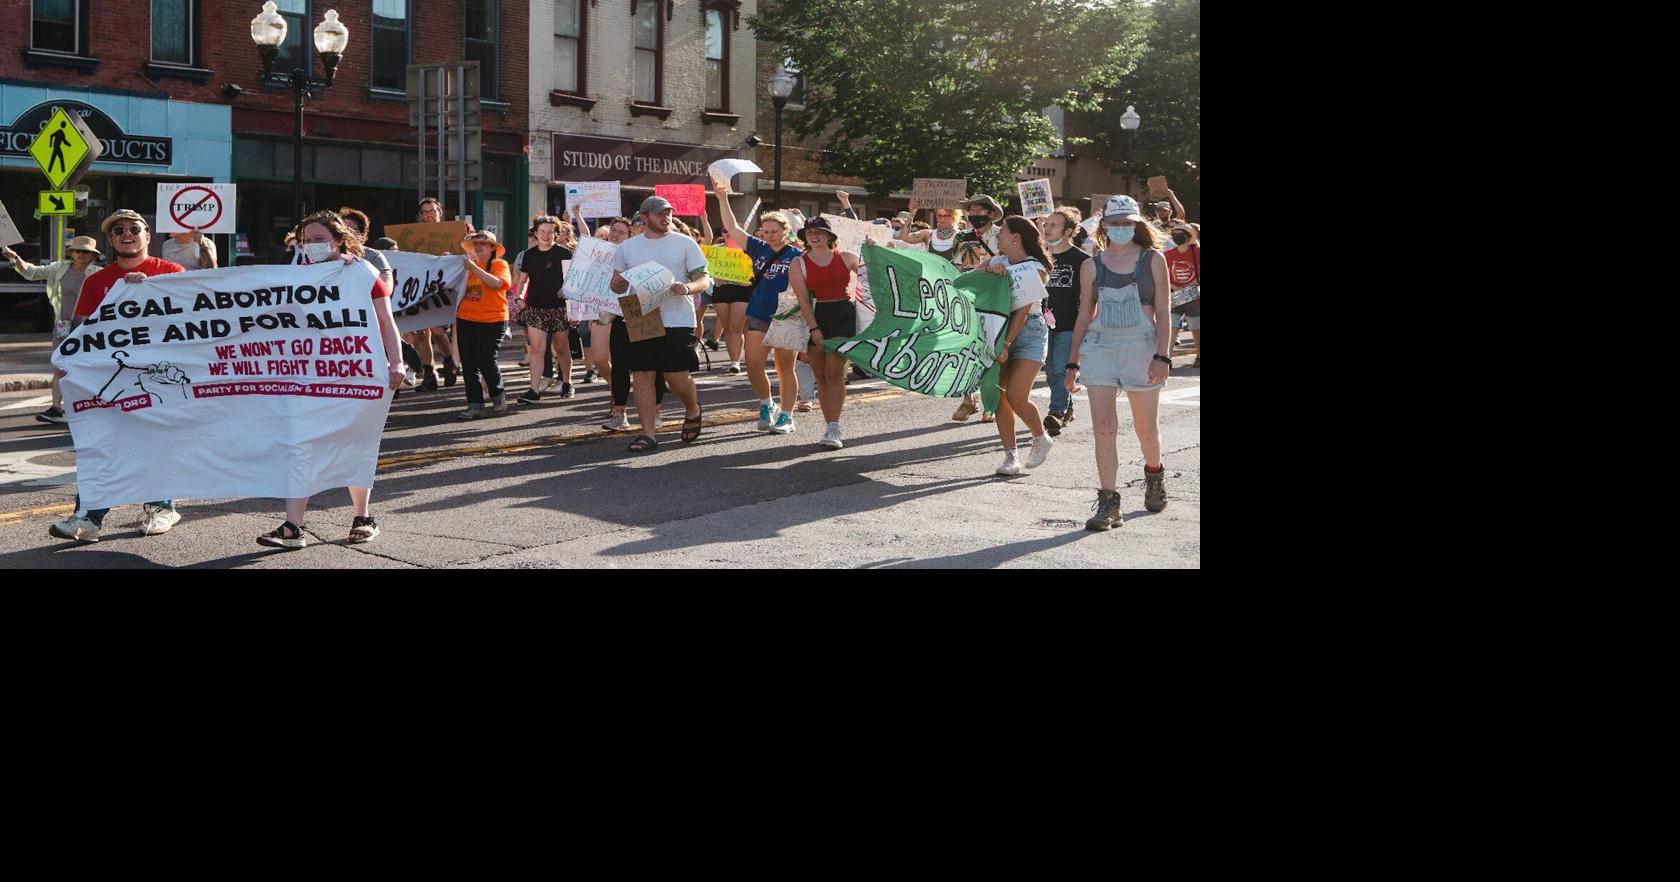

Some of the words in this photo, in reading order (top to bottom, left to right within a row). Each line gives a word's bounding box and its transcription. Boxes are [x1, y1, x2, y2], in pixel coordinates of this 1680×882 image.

[563, 150, 611, 169] STUDIO
[614, 155, 630, 171] OF
[634, 156, 660, 173] THE
[663, 159, 702, 176] DANCE
[1027, 167, 1056, 177] STREET
[83, 296, 183, 325] LEGAL
[192, 285, 340, 312] ABORTION
[397, 276, 420, 308] go
[886, 265, 971, 335] Legal
[59, 325, 151, 356] ONCE
[161, 318, 230, 343] AND
[239, 312, 300, 333] FOR
[307, 308, 368, 331] ALL!
[215, 345, 237, 360] WE
[239, 341, 285, 358] WON'T
[290, 338, 313, 356] GO
[319, 335, 372, 355] BACK
[208, 362, 229, 377] WE
[231, 361, 264, 376] WILL
[267, 359, 310, 376] FIGHT
[315, 359, 374, 378] BACK!
[197, 386, 232, 396] PARTY
[234, 384, 256, 393] FOR
[259, 383, 302, 393] SOCIALISM
[304, 385, 312, 393] &
[315, 386, 380, 398] LIBERATION
